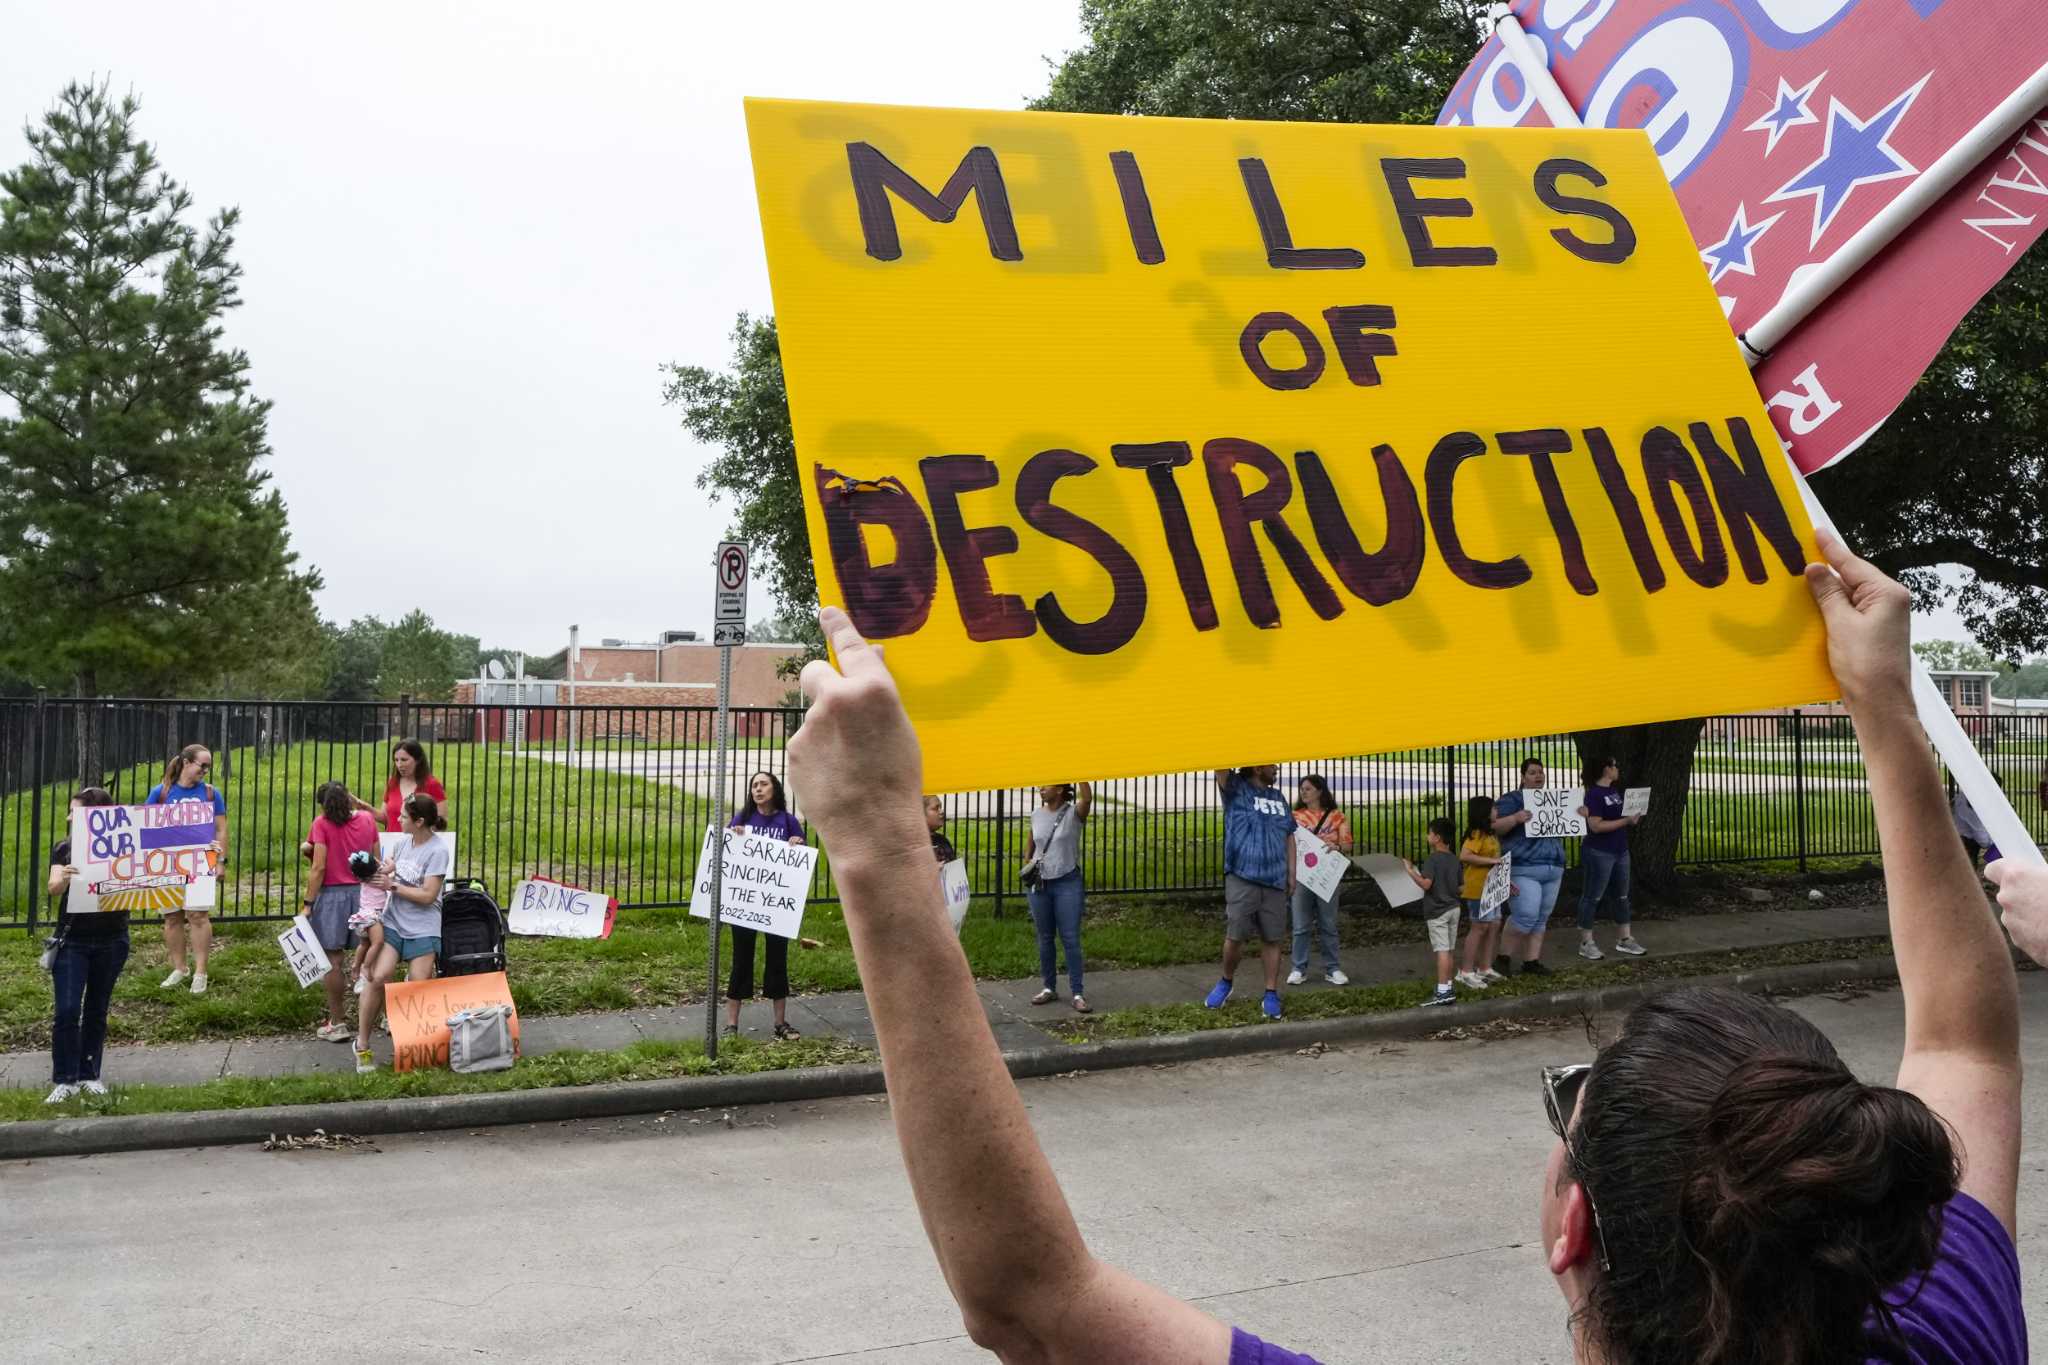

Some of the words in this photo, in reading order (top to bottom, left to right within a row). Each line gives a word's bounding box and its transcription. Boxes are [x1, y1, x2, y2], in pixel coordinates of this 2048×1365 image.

[846, 140, 1638, 270] MILES
[1239, 303, 1398, 391] OF
[814, 416, 1807, 654] DESTRUCTION
[1253, 796, 1286, 817] JETS
[1533, 790, 1570, 808] SAVE
[89, 806, 132, 836] OUR
[1531, 820, 1581, 837] SCHOOLS
[1538, 808, 1569, 824] OUR
[92, 833, 135, 859] OUR
[743, 838, 810, 870] SARABIA
[522, 884, 590, 915] BRING
[728, 887, 757, 903] THE
[761, 891, 796, 912] YEAR
[720, 904, 772, 926] 2022-2023
[394, 993, 437, 1021] We
[443, 993, 475, 1015] love
